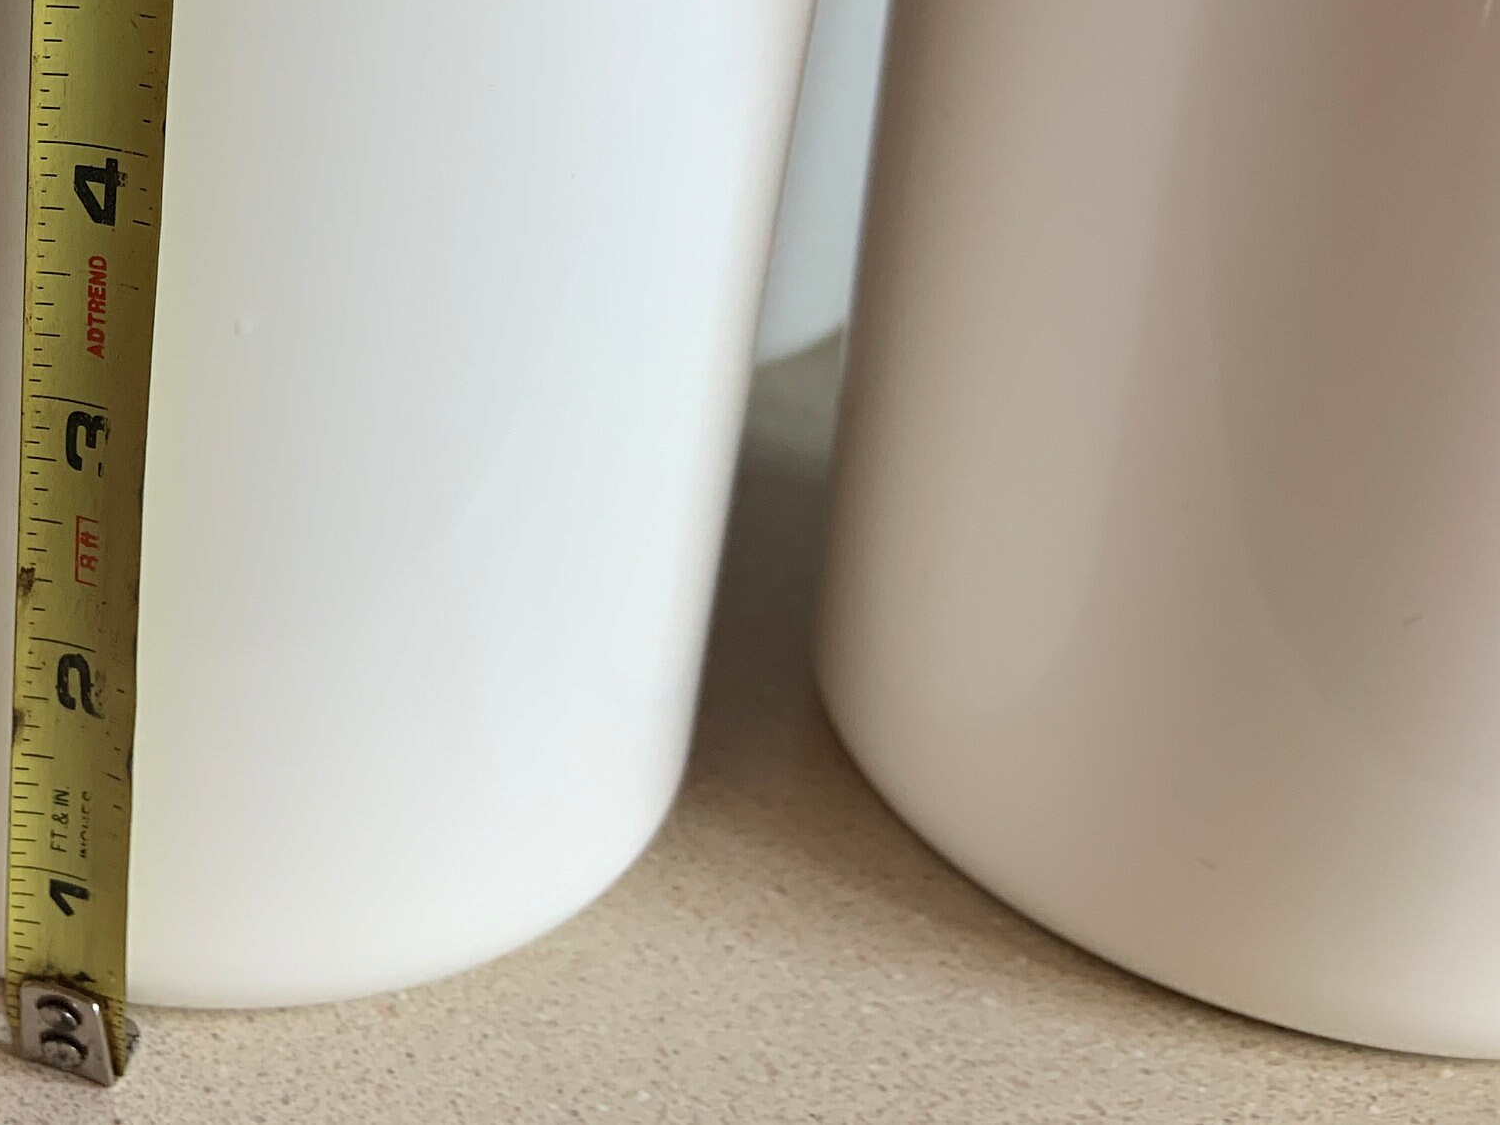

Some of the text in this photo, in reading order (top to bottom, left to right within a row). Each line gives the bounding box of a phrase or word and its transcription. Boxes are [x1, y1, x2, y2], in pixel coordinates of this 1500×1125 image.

[74, 158, 127, 227] 4
[86, 255, 108, 359] ADTREND
[66, 410, 110, 478] 3
[56, 653, 102, 718] 2
[49, 878, 90, 918] 1
